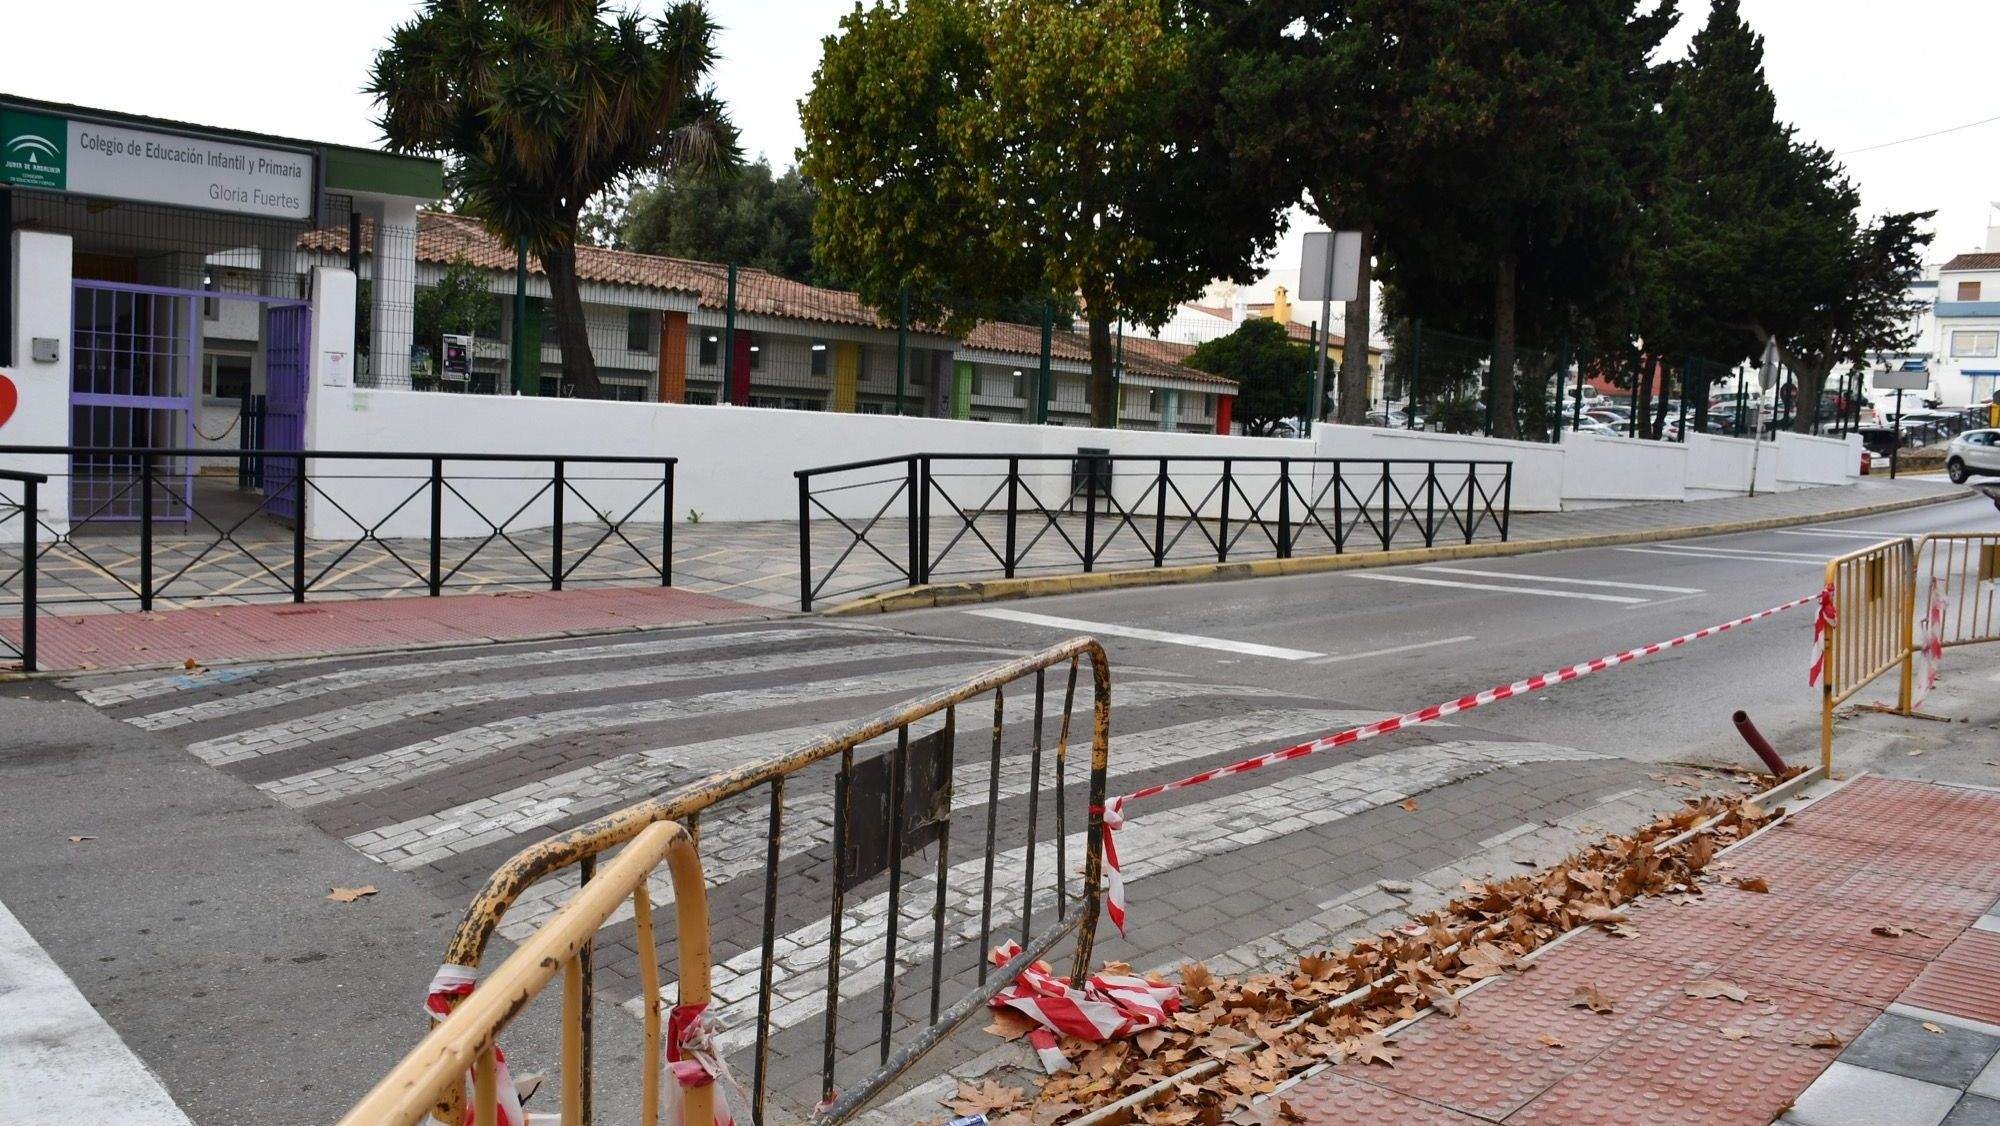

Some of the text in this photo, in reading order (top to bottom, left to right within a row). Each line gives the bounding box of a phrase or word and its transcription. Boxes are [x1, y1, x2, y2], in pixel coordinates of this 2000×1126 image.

[80, 132, 302, 178] Colegio de Educación Infantil y Primaria
[209, 183, 300, 209] Gloria Fuertes
